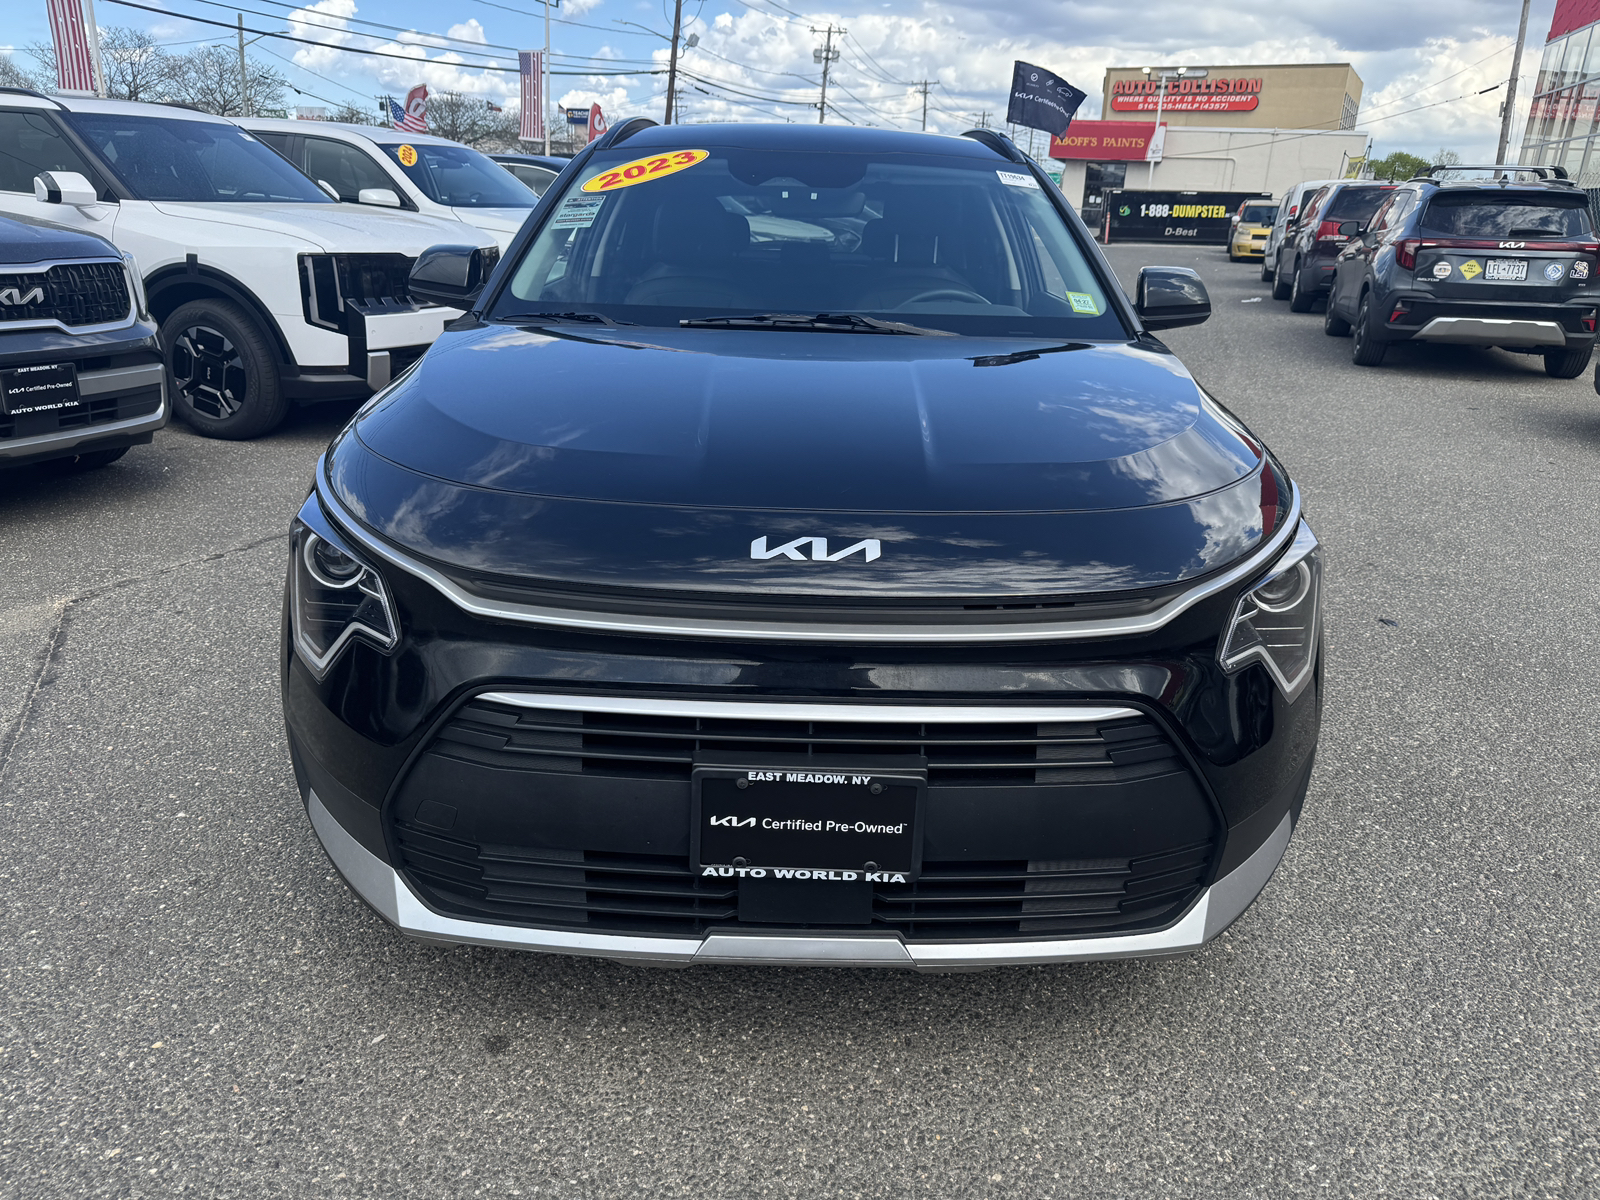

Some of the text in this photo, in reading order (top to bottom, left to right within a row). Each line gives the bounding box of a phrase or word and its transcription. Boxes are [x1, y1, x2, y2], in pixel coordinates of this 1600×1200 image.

[1112, 78, 1263, 95] AUTO COLLISION
[1117, 95, 1145, 103] WHERE
[1183, 95, 1193, 103] IS
[1210, 95, 1254, 103] ACCIDENT
[1054, 136, 1145, 148] ABOFF'S PAINTS
[598, 151, 697, 189] 2023
[1164, 227, 1198, 236] D-Best
[1487, 264, 1525, 275] LFL 7737
[8, 387, 25, 395] KIA
[25, 384, 47, 392] Certified
[10, 407, 33, 415] AUTO
[34, 402, 63, 412] WORLD
[750, 535, 881, 563] KIA
[747, 771, 782, 782] EAST
[851, 776, 872, 786] NY
[710, 815, 757, 828] KIA
[761, 817, 822, 832] Certified
[701, 866, 906, 883] AUTO WORLD KIA
